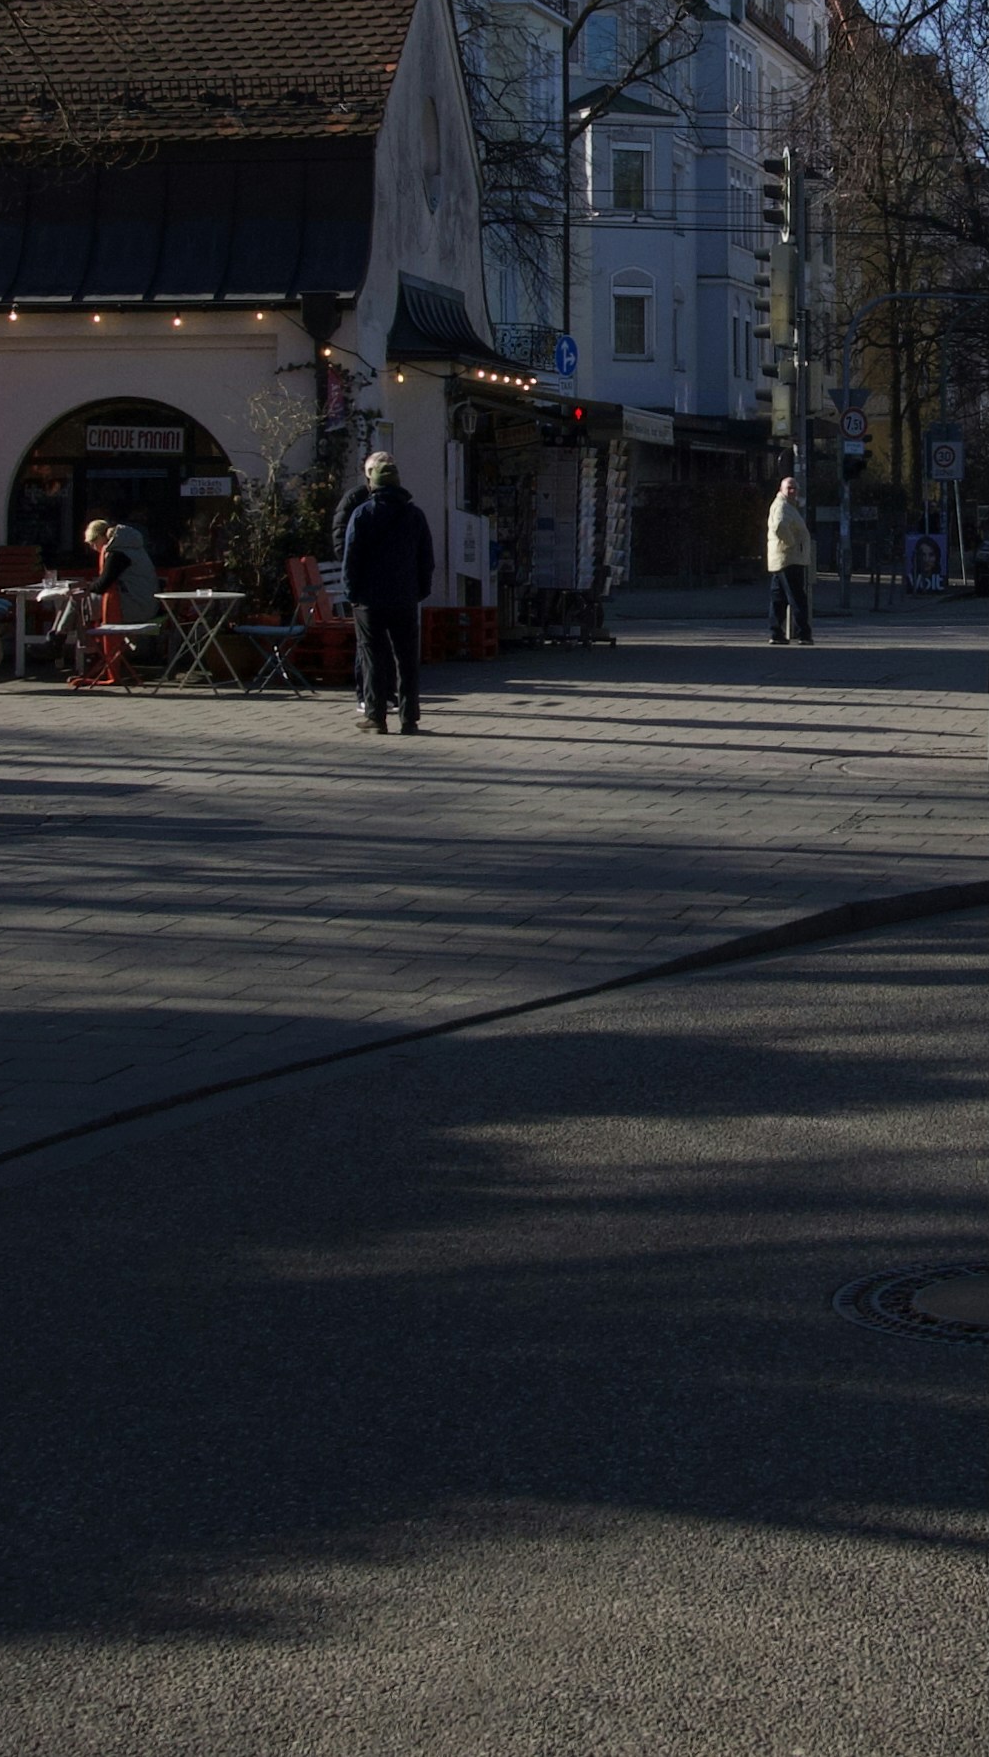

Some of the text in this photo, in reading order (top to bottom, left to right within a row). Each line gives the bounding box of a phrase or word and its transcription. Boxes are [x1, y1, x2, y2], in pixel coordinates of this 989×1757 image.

[89, 429, 180, 450] CINQUE PANINI
[938, 451, 951, 462] 30
[908, 573, 945, 591] Volt
